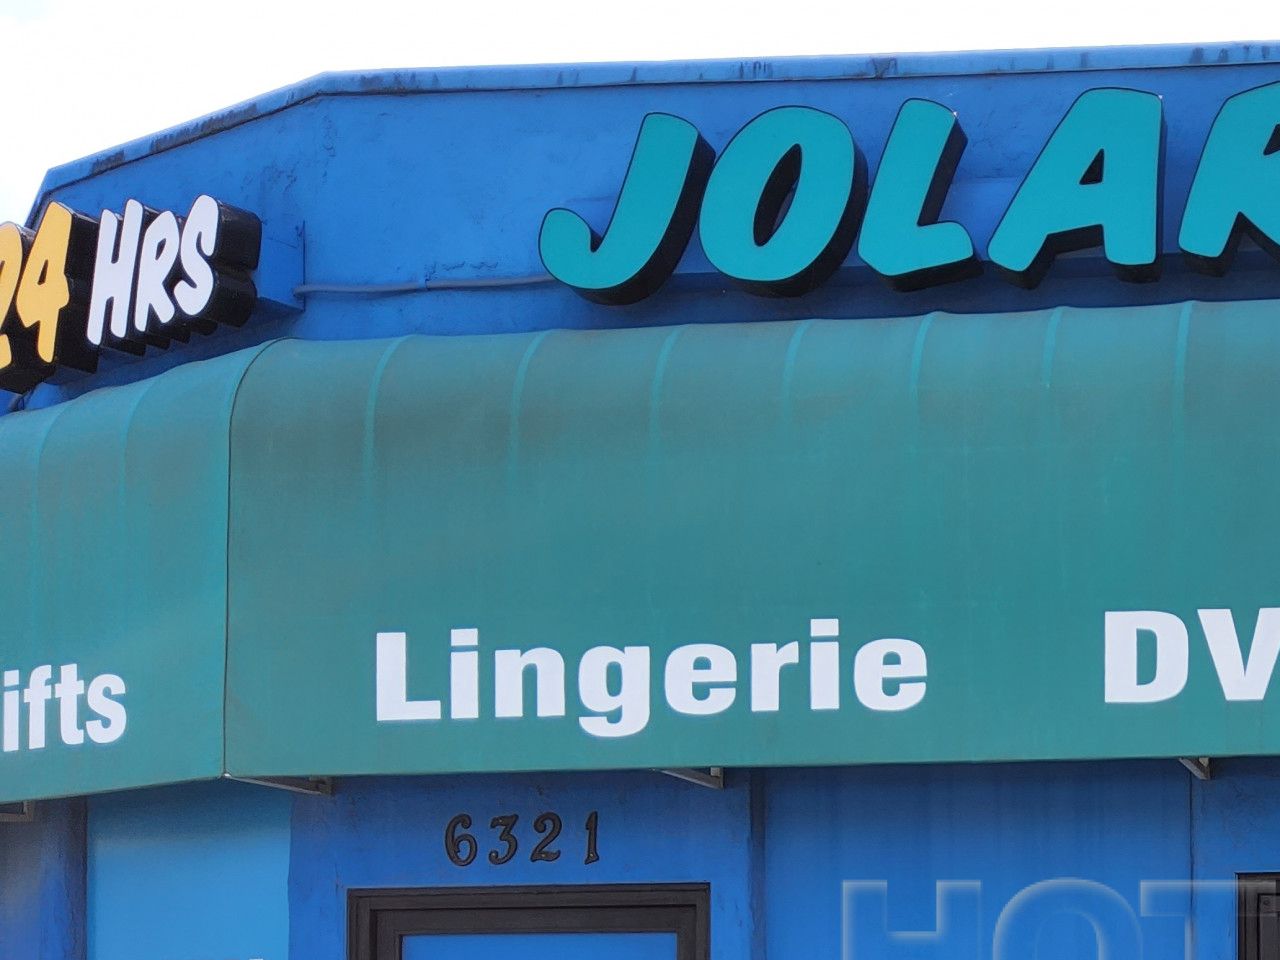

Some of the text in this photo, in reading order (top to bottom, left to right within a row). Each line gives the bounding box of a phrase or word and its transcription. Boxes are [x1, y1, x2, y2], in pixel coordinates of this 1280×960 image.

[87, 195, 219, 346] HRS
[376, 618, 928, 738] Lingerie
[445, 811, 600, 867] 6321
